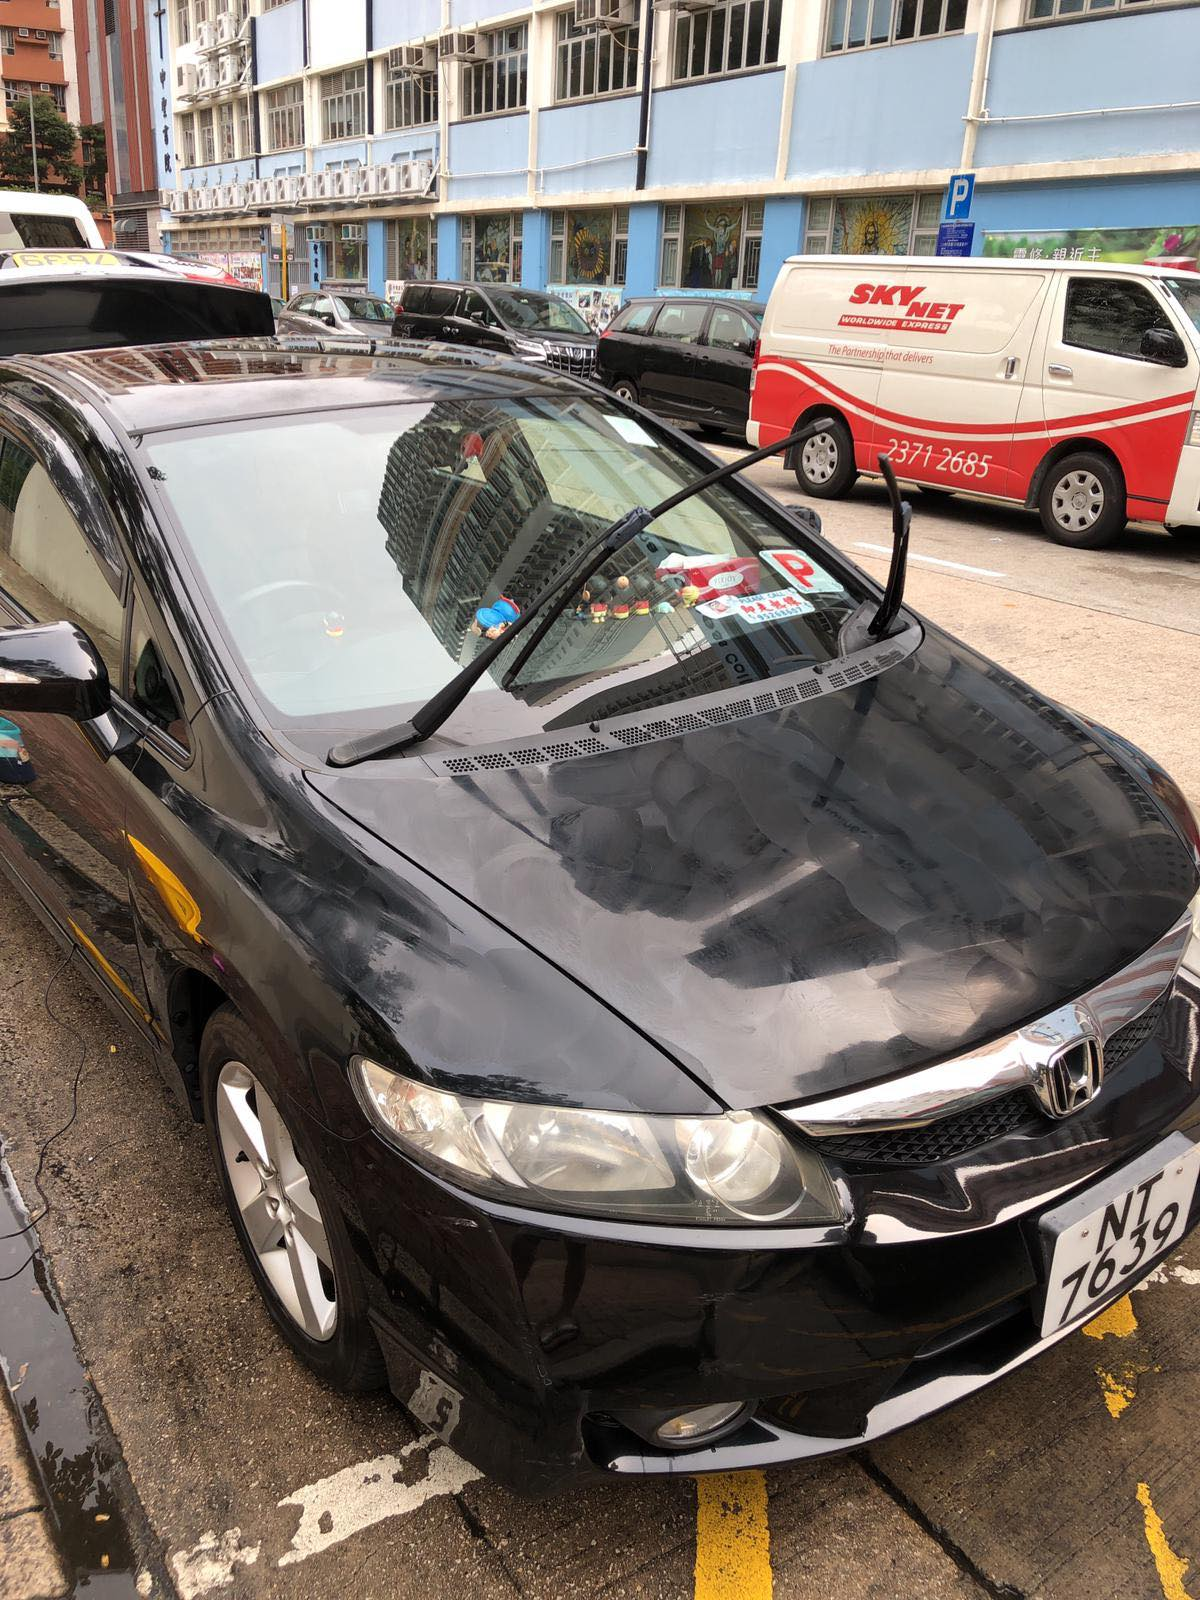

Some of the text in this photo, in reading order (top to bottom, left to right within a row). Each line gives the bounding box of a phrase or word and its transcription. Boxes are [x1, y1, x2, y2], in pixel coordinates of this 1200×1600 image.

[949, 178, 969, 216] P
[848, 283, 965, 320] SKY NET
[841, 315, 948, 331] WORLDWIDE EXPRESS
[828, 344, 934, 364] The Partnership that delivers
[887, 439, 993, 478] 2371 2685
[771, 553, 815, 588] P
[1095, 1168, 1165, 1255] NT
[1058, 1202, 1180, 1326] 7639
